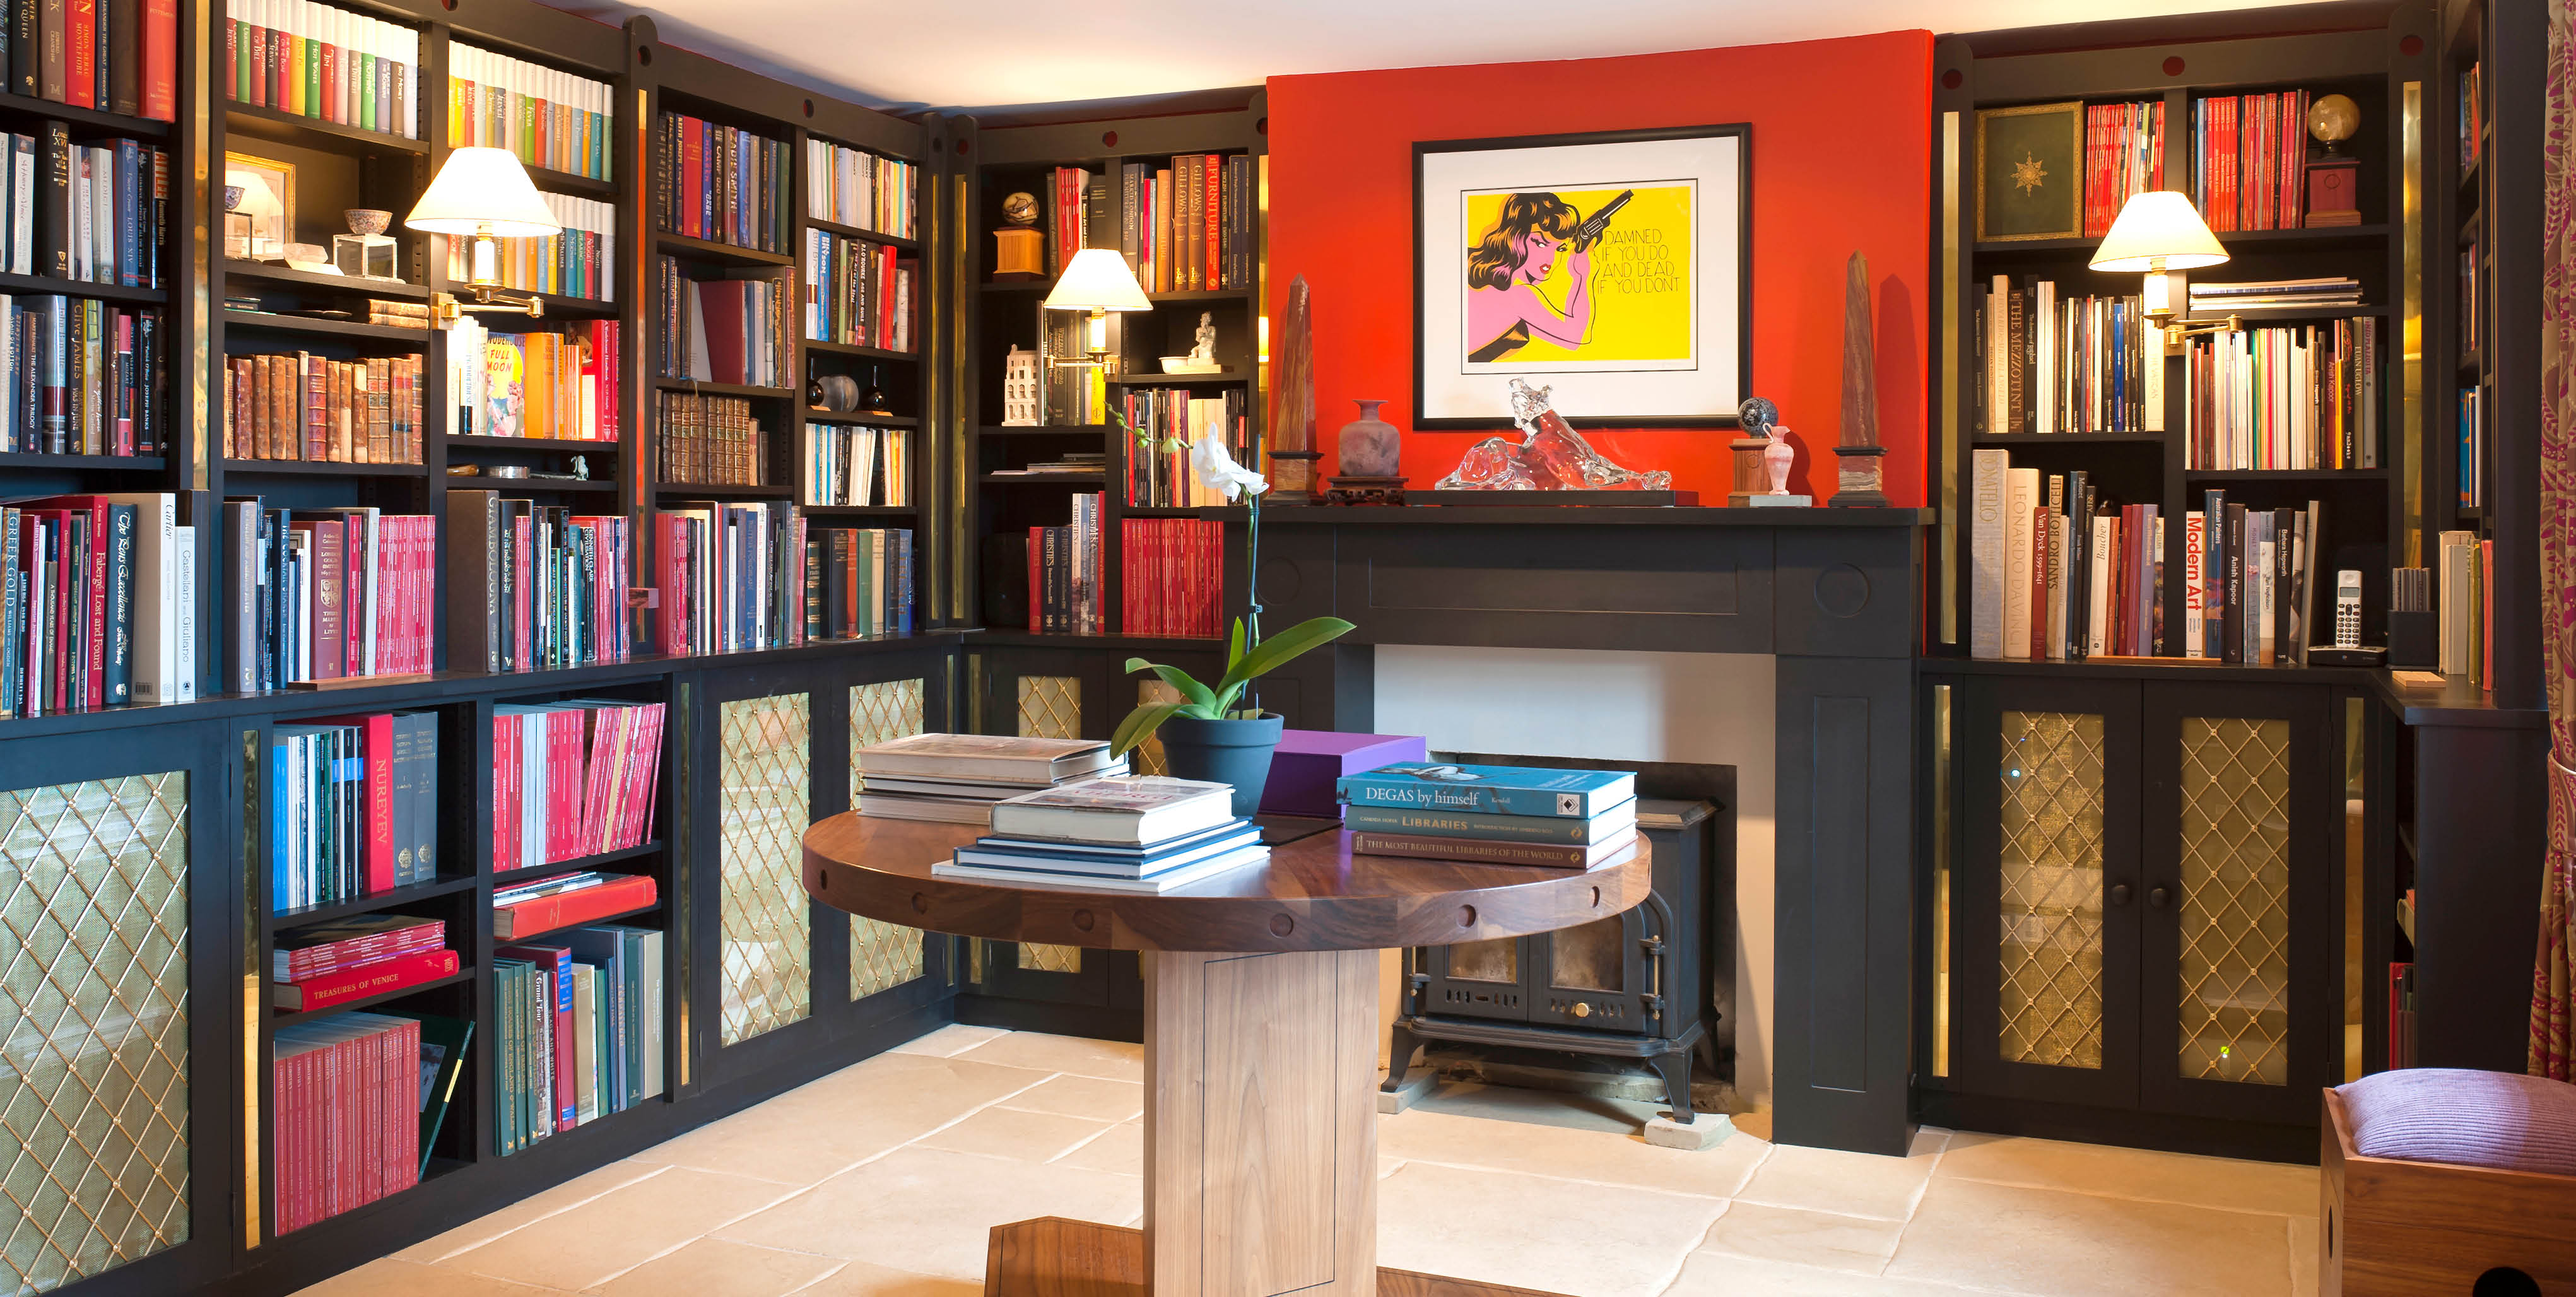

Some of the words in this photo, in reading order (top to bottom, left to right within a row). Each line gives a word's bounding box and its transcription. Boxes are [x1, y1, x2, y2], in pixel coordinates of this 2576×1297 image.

[21, 9, 29, 38] QUEEN
[155, 151, 168, 199] ATTLEE
[1193, 165, 1202, 212] GILLOWS
[1178, 167, 1187, 213] GILLOWS
[1208, 167, 1218, 240] FURNITURE
[1604, 228, 1662, 245] DAMNED
[1602, 247, 1611, 262] IF
[1618, 245, 1645, 261] YOU
[1649, 244, 1669, 261] DO
[1603, 262, 1632, 278] AND
[1637, 261, 1674, 277] DEAD
[1597, 279, 1608, 294] IF
[1614, 278, 1642, 294] YOU
[74, 305, 82, 336] Clive
[2011, 302, 2021, 330] THE
[71, 337, 82, 379] JAMES
[487, 361, 512, 372] MOON
[490, 349, 510, 360] FULL
[2011, 332, 2022, 412] MEZZOTINT
[2327, 380, 2335, 402] Kapoor
[71, 411, 79, 430] JUNE
[1979, 454, 1998, 523] DONATELLO
[2049, 478, 2062, 536] BOTTICELLI
[118, 512, 131, 534] The
[165, 505, 175, 539] Cartier
[2011, 485, 2027, 574] LEONARDO
[2037, 514, 2047, 529] Van
[8, 517, 18, 564] GREEK
[117, 537, 130, 563] Pens
[2036, 531, 2047, 551] Dyck
[2096, 524, 2107, 560] Boucher
[2187, 517, 2202, 582] Modern
[182, 550, 191, 602] Castellani
[2049, 541, 2059, 590] SANDRO
[2280, 551, 2288, 577] Hepworth
[6, 567, 16, 607] GOLD
[2011, 580, 2025, 601] DA
[2187, 584, 2202, 611] Art
[2229, 578, 2238, 606] Kapoor
[94, 594, 104, 616] Lost
[94, 619, 103, 637] and
[2009, 602, 2025, 647] VINCI
[182, 617, 191, 662] Giuliano
[93, 638, 103, 671] Found
[376, 758, 387, 844] NUREYEV
[1366, 787, 1414, 802] DEGAS
[1417, 789, 1431, 807] by
[1435, 790, 1479, 806] himself
[1401, 816, 1468, 831] LIBRARIES
[1366, 840, 1383, 848] THE
[1385, 842, 1409, 850] MOST
[1411, 843, 1454, 854] BEAUTIFUL
[1456, 846, 1497, 856] LIBRARIES
[1498, 848, 1510, 857] OF
[1512, 849, 1529, 857] THE
[1531, 850, 1563, 860] WORLD
[314, 984, 356, 1001] TREASURES
[358, 980, 370, 990] OF
[372, 973, 399, 987] VENICE
